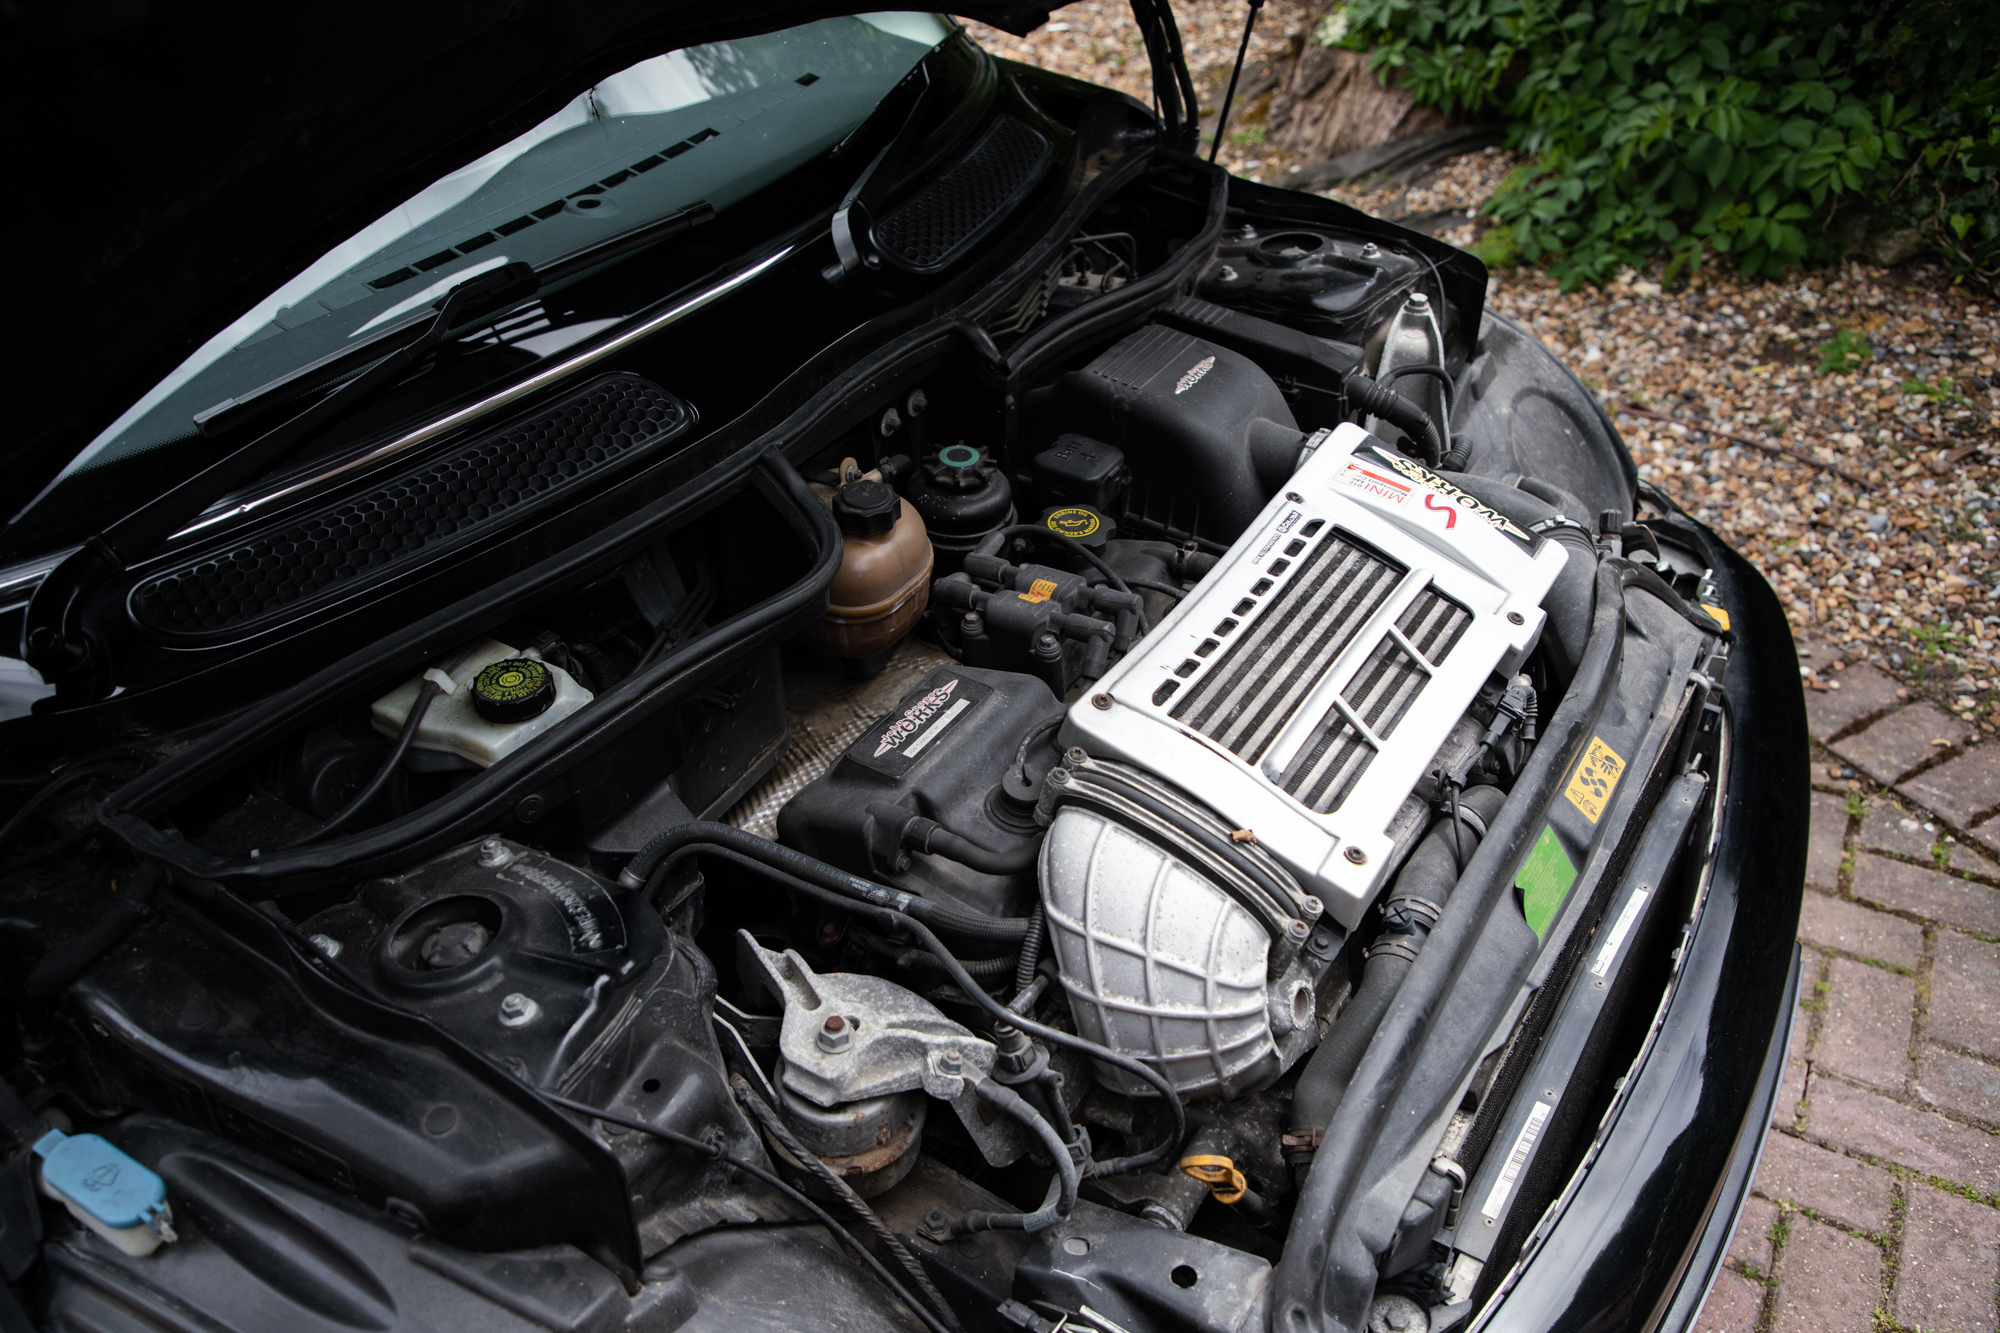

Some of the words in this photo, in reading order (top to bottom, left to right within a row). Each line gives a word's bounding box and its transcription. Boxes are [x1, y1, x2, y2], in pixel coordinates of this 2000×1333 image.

[1054, 440, 1083, 460] Batt
[1364, 482, 1405, 504] MINI
[1397, 459, 1508, 530] WORKS
[1053, 509, 1077, 519] ENGINE
[1078, 510, 1088, 518] OIL
[1083, 518, 1096, 533] MANUAL
[904, 688, 942, 717] Cooper
[885, 691, 949, 746] WORKS
[731, 830, 750, 842] BMW
[781, 846, 800, 861] FUEL
